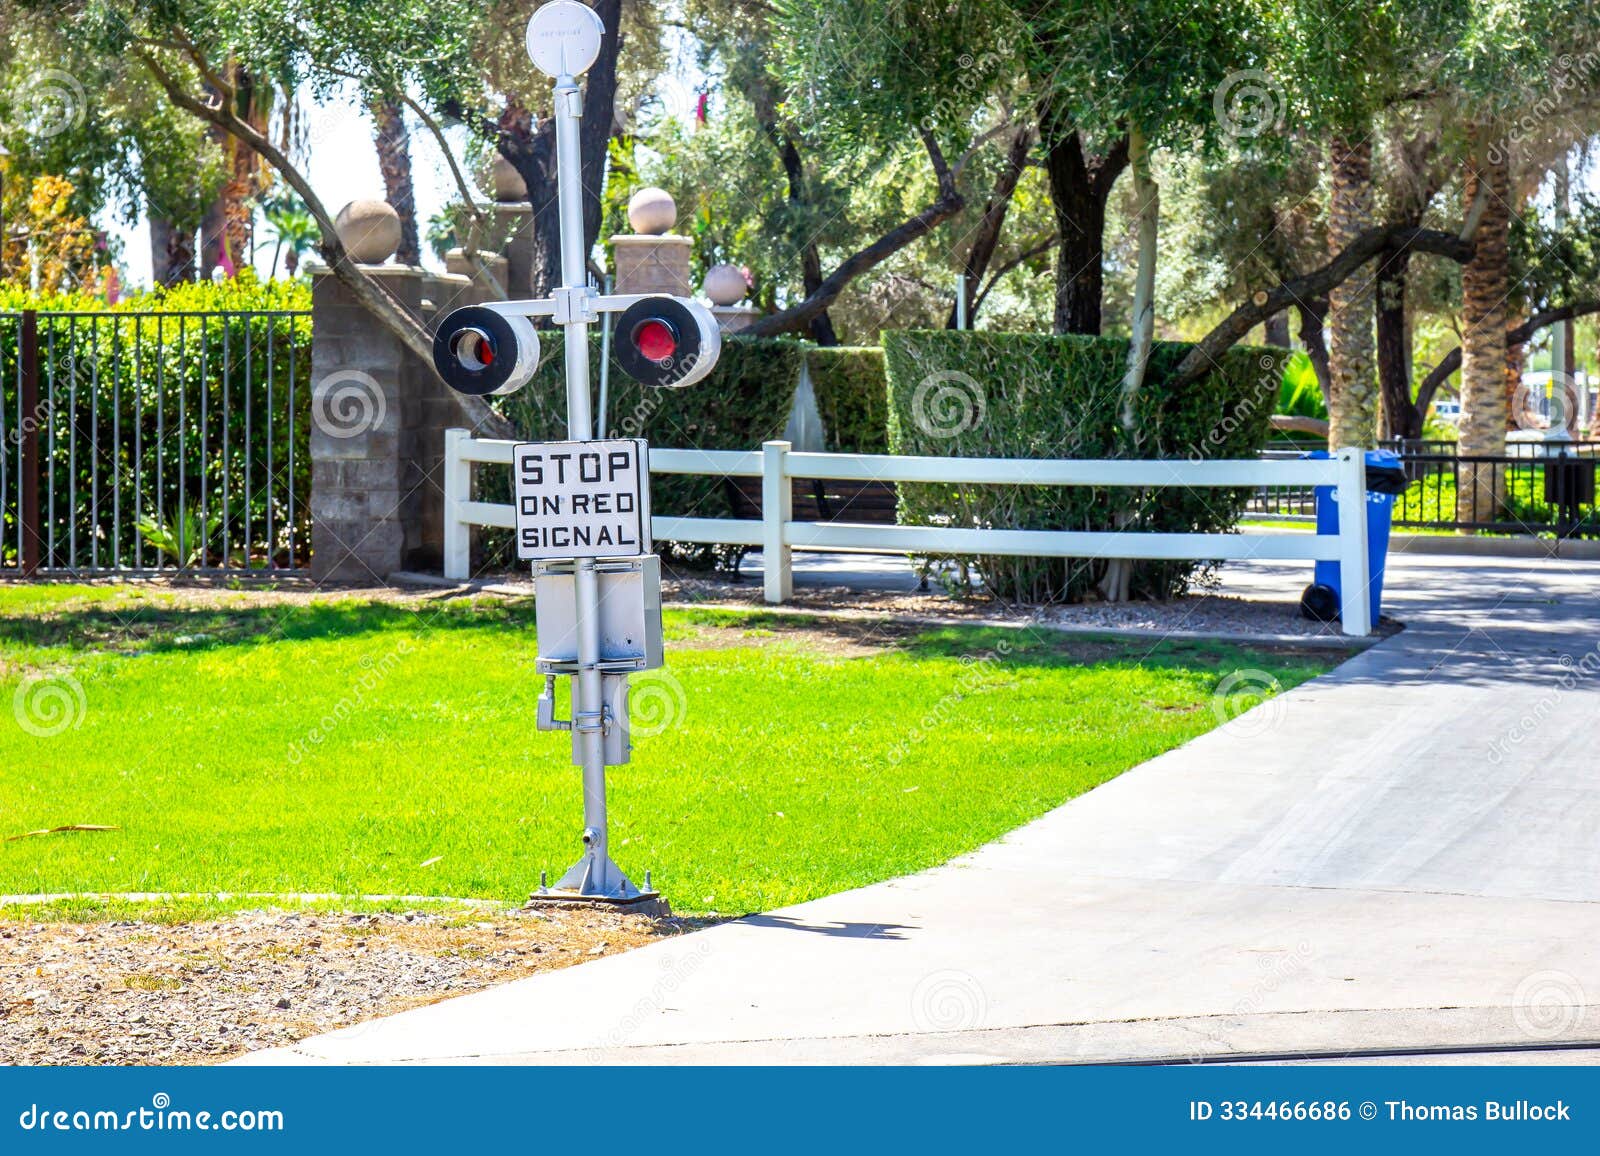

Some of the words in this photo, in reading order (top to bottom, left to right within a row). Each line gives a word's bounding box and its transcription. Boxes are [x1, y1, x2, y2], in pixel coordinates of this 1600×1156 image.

[521, 452, 630, 484] STOP
[521, 495, 560, 515] ON
[572, 493, 634, 514] RED
[522, 525, 635, 547] SIGNAL
